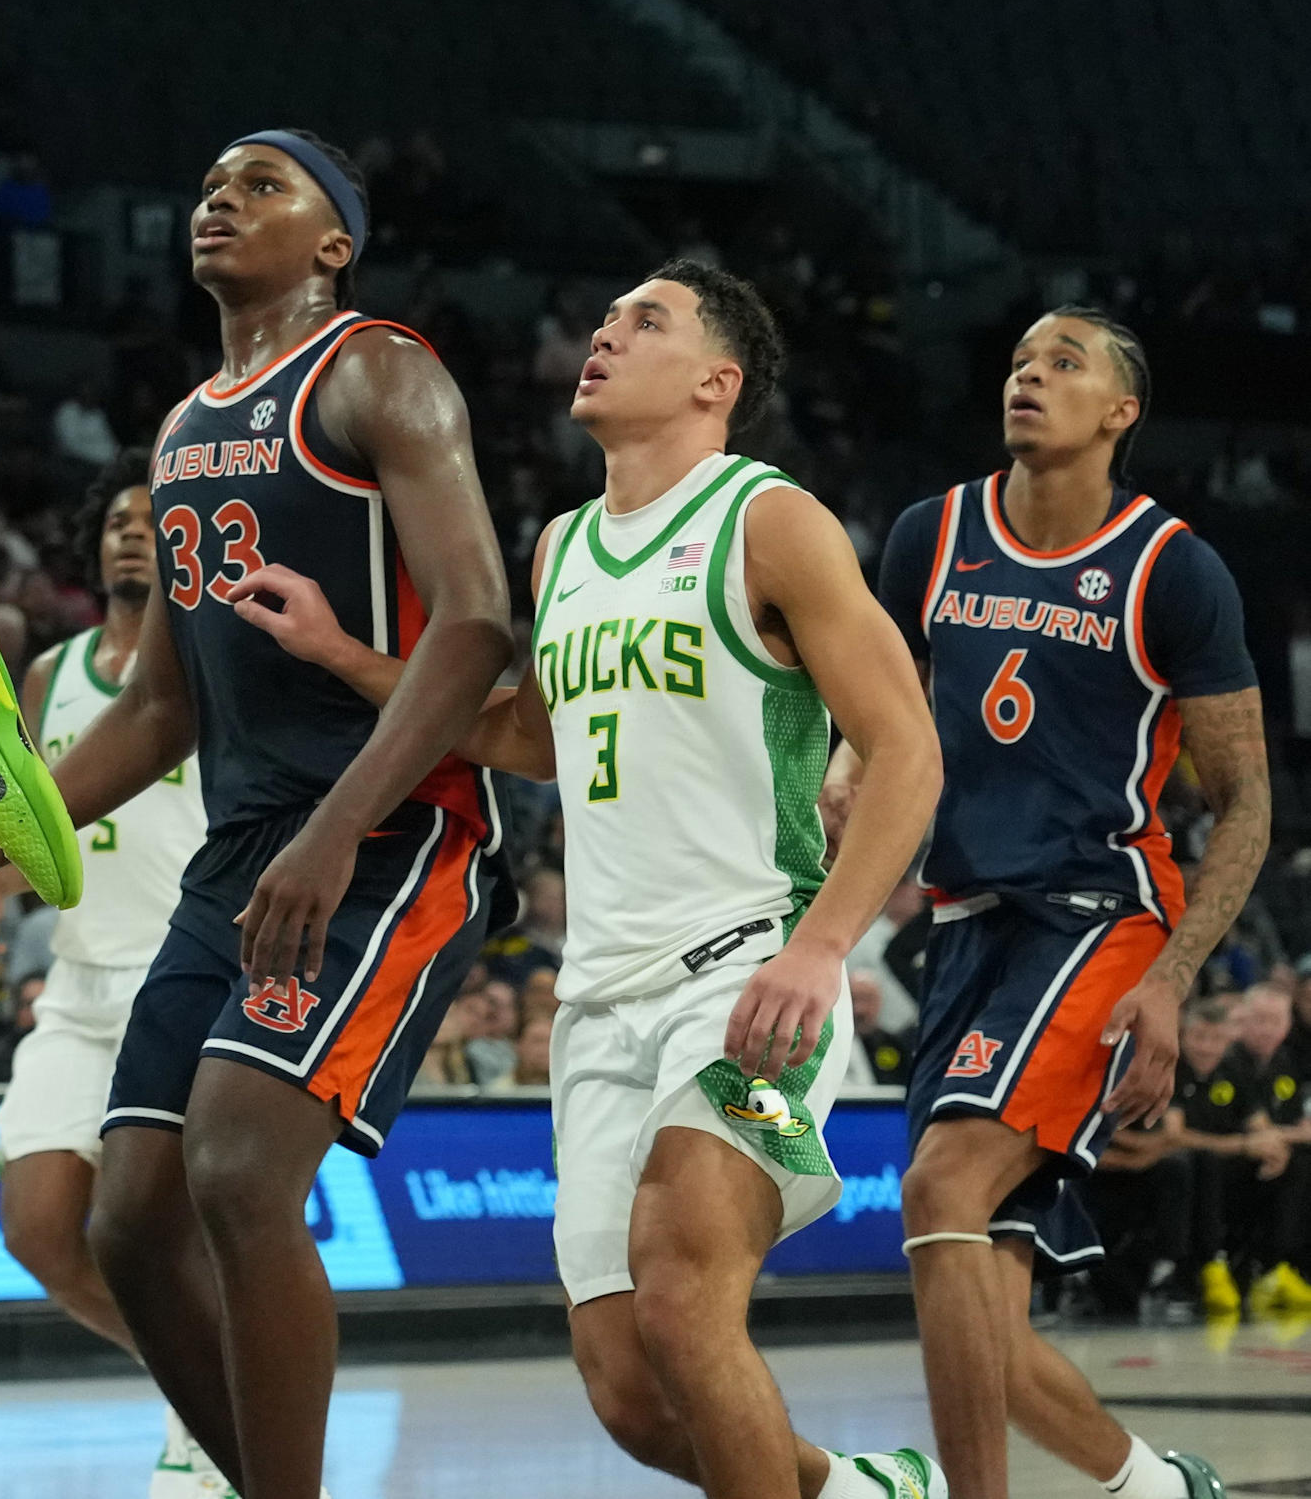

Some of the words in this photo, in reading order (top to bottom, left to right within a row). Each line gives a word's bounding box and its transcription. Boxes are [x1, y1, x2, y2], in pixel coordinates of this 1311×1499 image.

[249, 398, 277, 432] SEC
[150, 437, 284, 496] AUBURN
[158, 498, 267, 612] 33
[1077, 568, 1112, 602] SEC
[933, 589, 1119, 652] AUBURN
[537, 615, 708, 719] DUCKS
[980, 648, 1035, 745] 6
[587, 710, 620, 805] 3
[405, 1169, 482, 1220] Like
